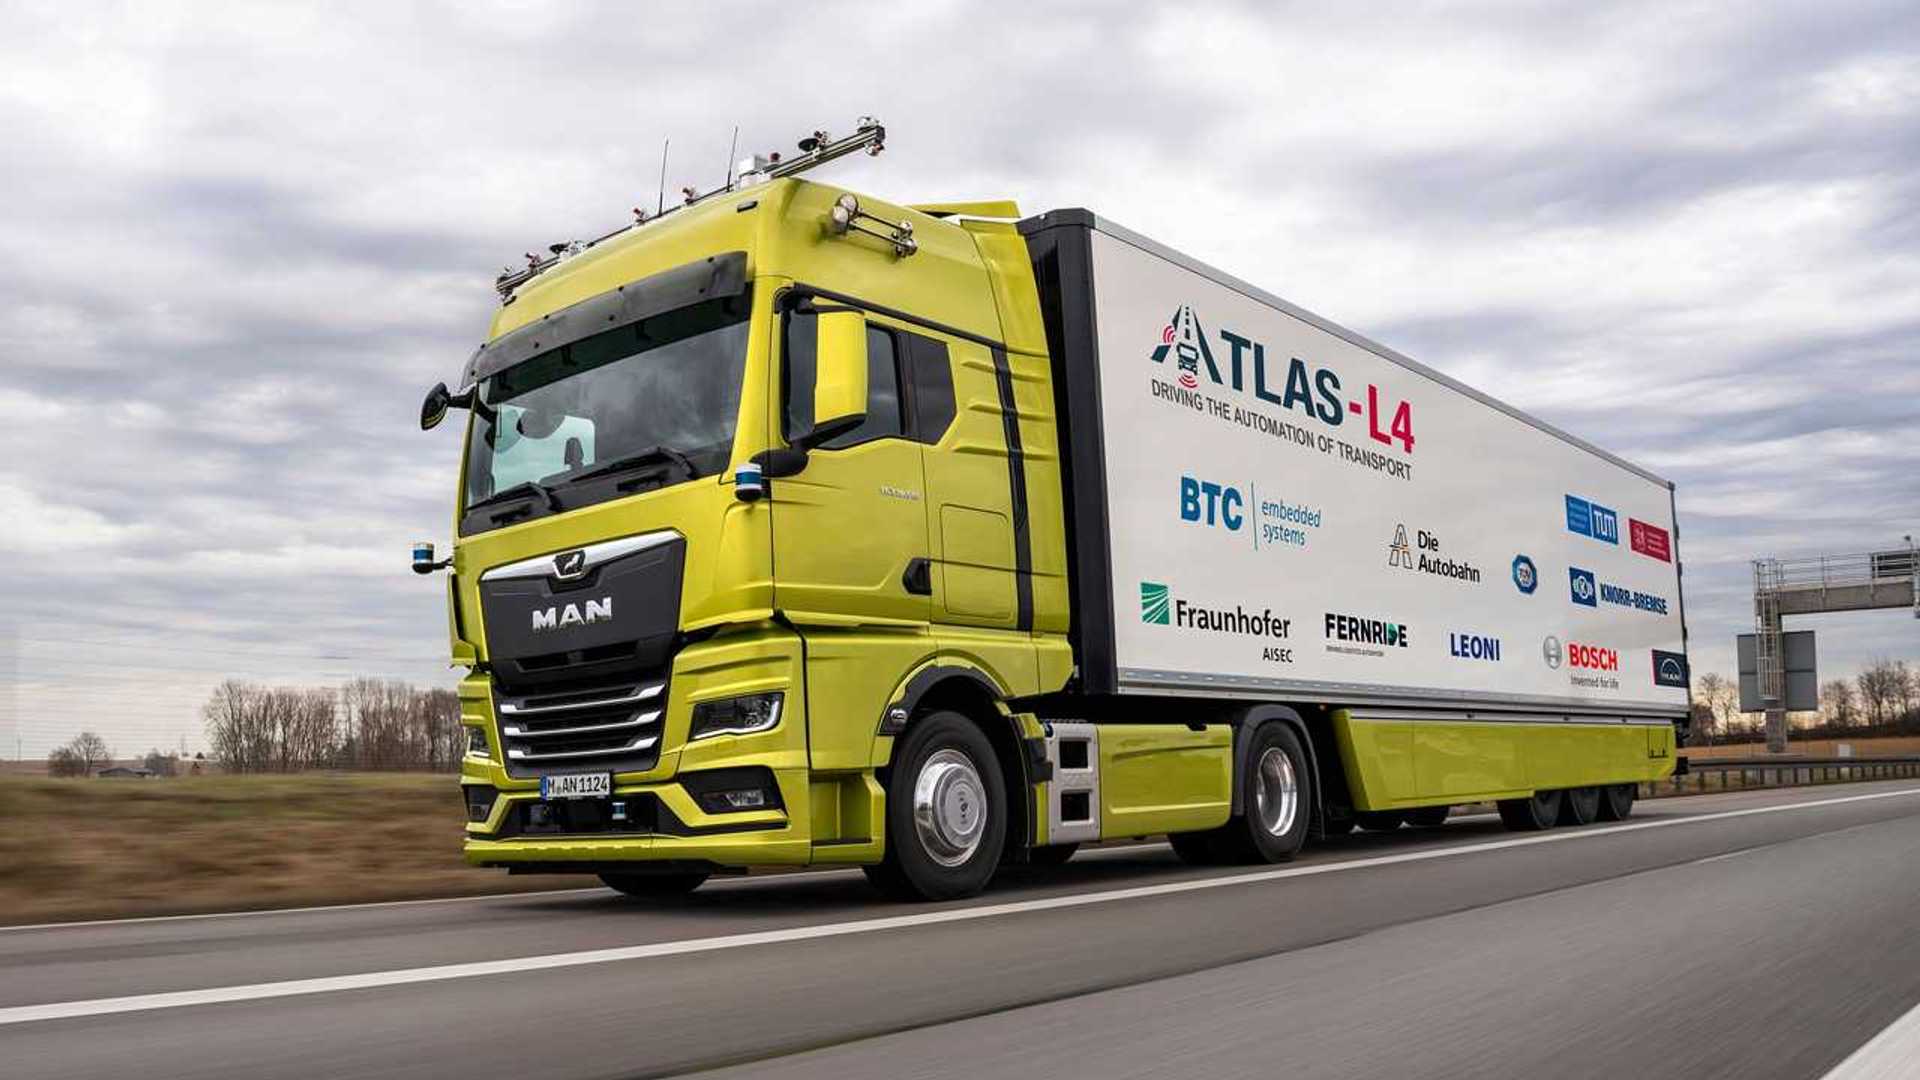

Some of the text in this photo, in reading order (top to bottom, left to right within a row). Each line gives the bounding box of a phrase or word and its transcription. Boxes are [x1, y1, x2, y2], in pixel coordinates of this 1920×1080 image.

[1152, 379, 1412, 481] DRIVING THE AUTOMATION OF TRANSPORT
[1181, 476, 1243, 531] BTC
[1261, 500, 1321, 528] embedded
[1263, 523, 1305, 546] systems
[1417, 530, 1439, 551] Die
[1418, 553, 1480, 583] Autobahn
[532, 597, 612, 630] MAN
[1600, 583, 1668, 615] KNORR-BREMSE
[1176, 600, 1290, 638] Fraunhofer
[1325, 613, 1407, 647] FERNRIDE
[1263, 647, 1293, 663] AISEC
[1450, 633, 1500, 661] LEONI
[1569, 644, 1618, 671] BOSCH
